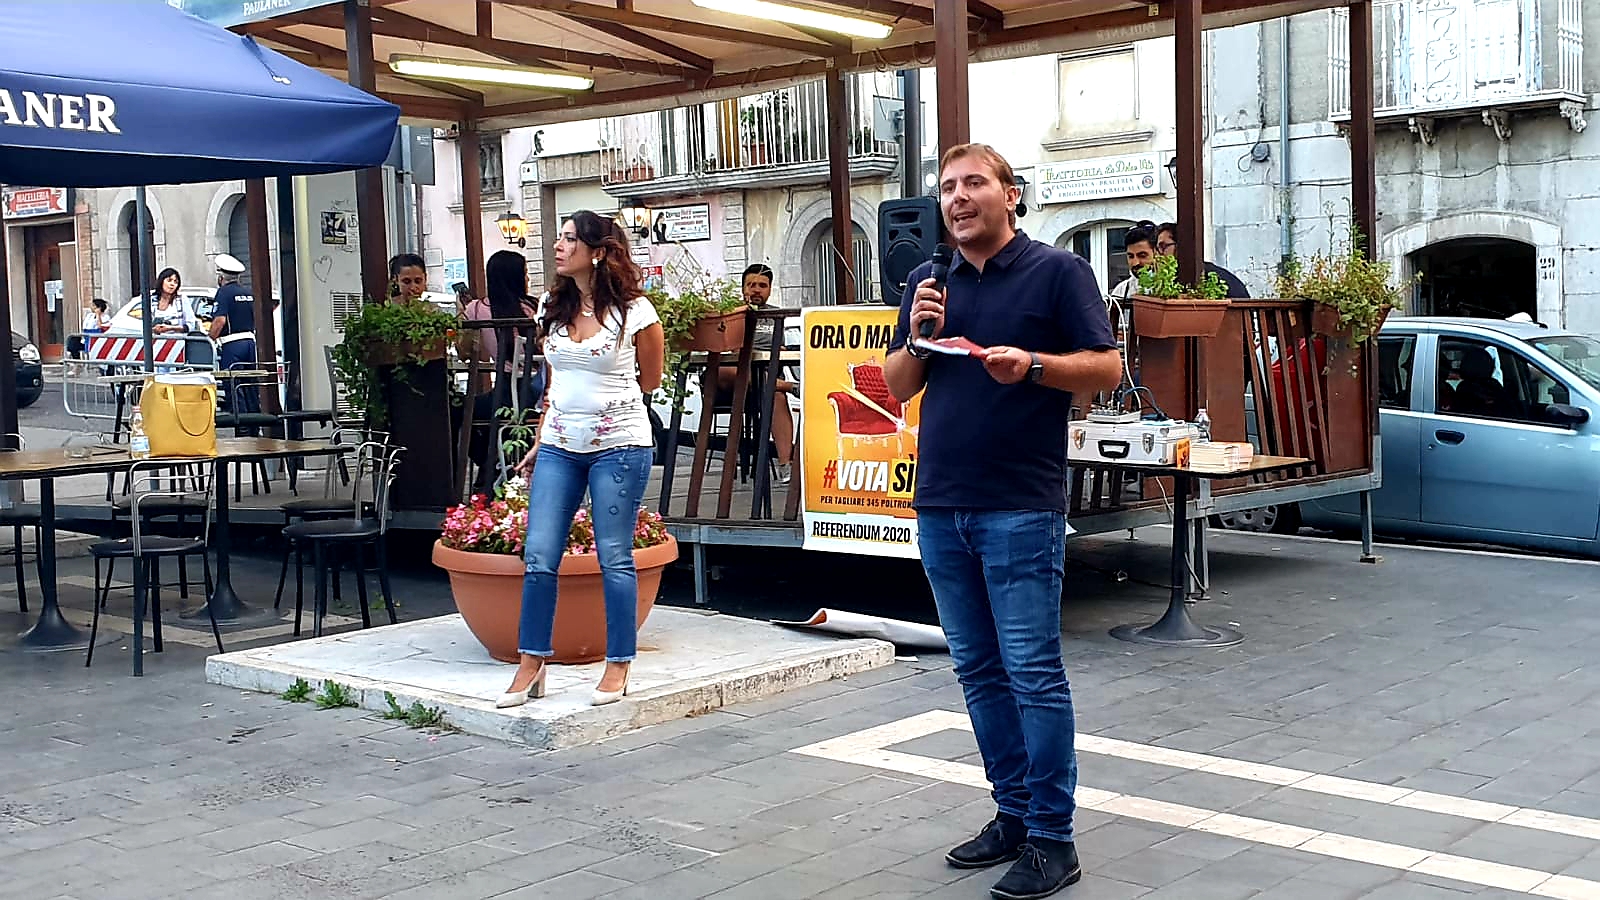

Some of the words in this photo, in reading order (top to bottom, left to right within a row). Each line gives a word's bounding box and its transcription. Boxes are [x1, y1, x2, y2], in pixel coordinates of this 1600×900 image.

[1540, 257, 1555, 268] 29
[810, 325, 845, 349] ORA
[849, 325, 861, 349] O
[865, 325, 897, 349] MA
[823, 459, 888, 492] #VOTA
[893, 454, 915, 493] SÌ
[820, 495, 833, 505] PER
[835, 496, 865, 507] TAGLIARE
[867, 498, 880, 507] 345
[813, 521, 880, 540] REFERENDUM
[883, 526, 911, 543] 2020
